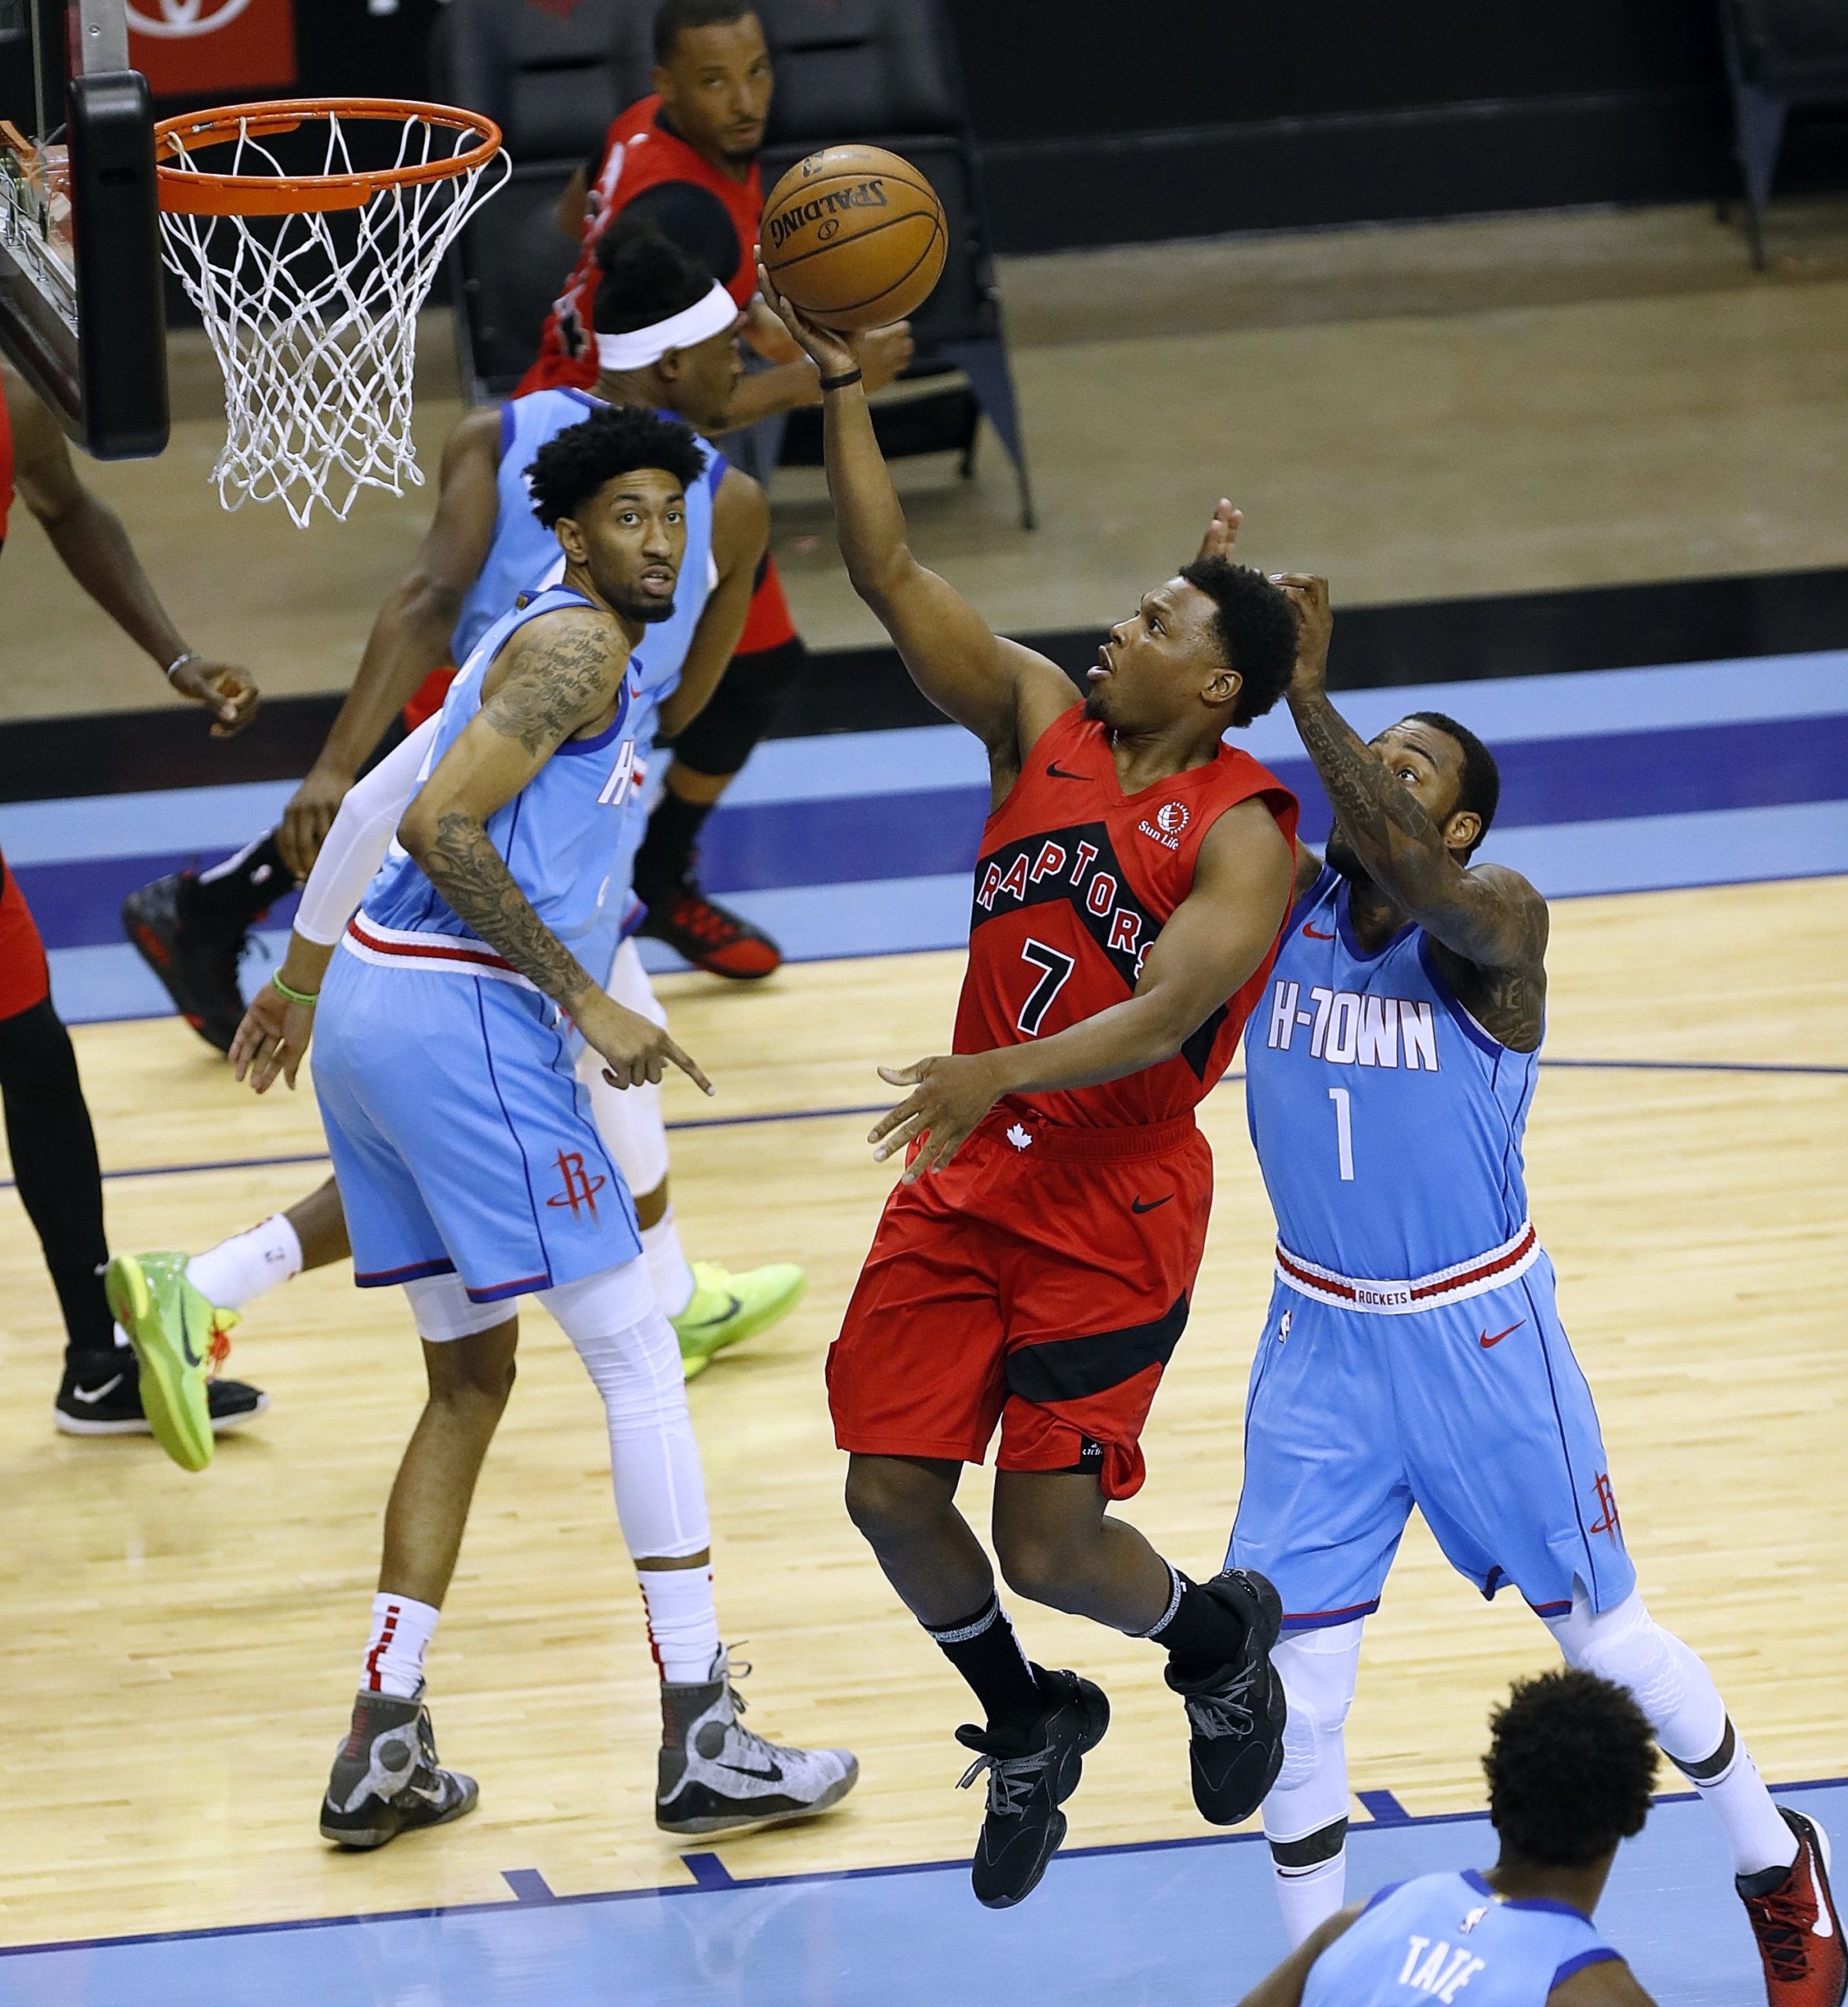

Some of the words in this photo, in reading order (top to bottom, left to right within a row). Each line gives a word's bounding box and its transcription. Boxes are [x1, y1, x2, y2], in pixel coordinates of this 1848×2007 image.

[770, 179, 888, 249] SPALDING
[1138, 819, 1161, 841] Sun
[1160, 833, 1179, 851] Life
[1016, 937, 1076, 1036] 7
[1266, 979, 1440, 1073] H-TOWN
[1327, 1087, 1355, 1181] 1
[1358, 1289, 1408, 1306] ROCKETS
[1397, 1933, 1487, 2006] TATE
